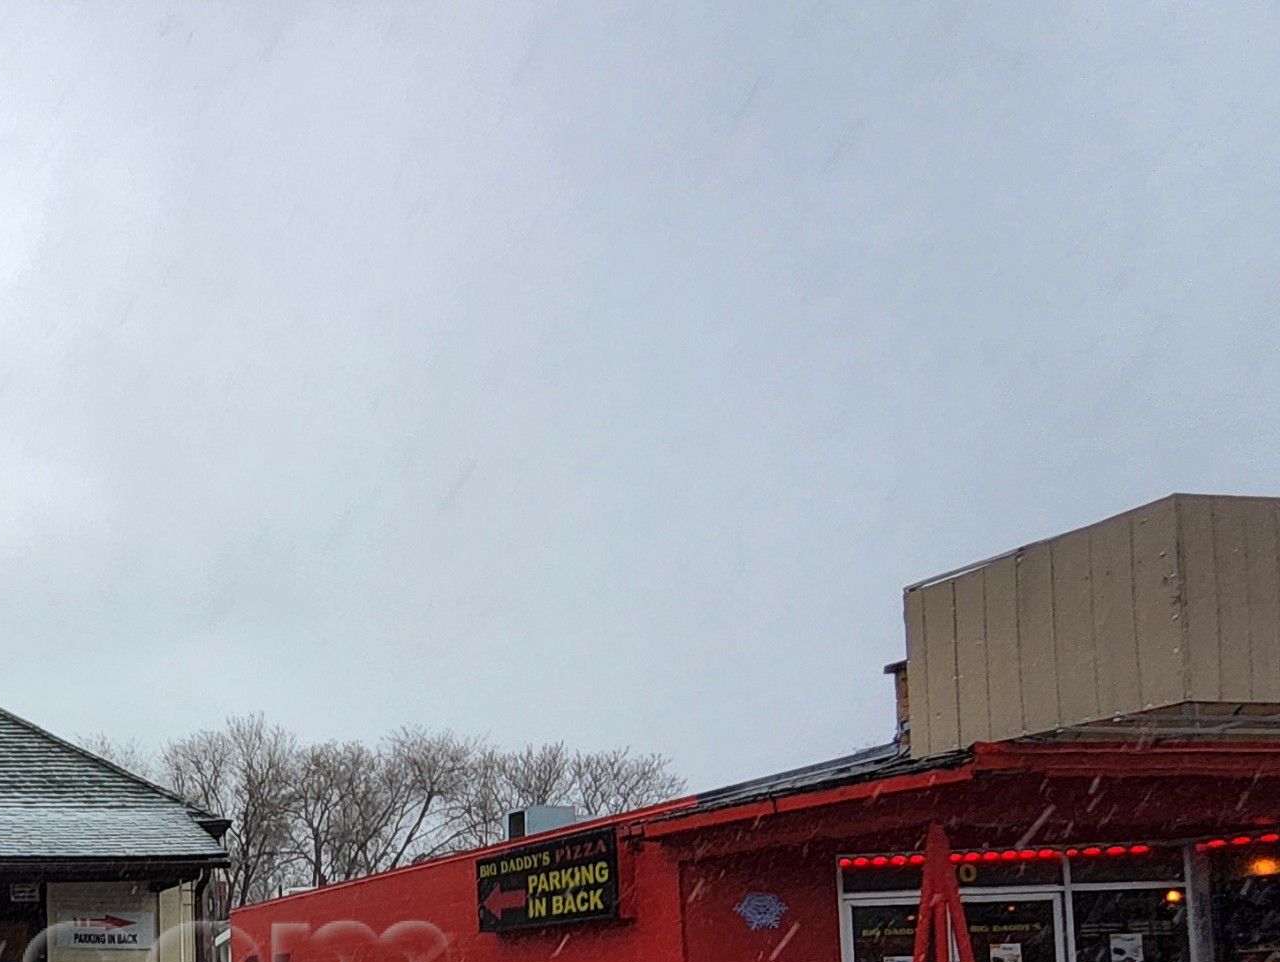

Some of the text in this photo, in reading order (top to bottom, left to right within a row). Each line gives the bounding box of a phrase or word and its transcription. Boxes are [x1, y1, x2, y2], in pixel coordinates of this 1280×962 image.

[480, 841, 606, 879] BIG DADDY'S PIZZA
[528, 862, 609, 895] PARKING
[528, 888, 605, 919] IN BACK
[73, 933, 138, 944] PARKING IN BACK
